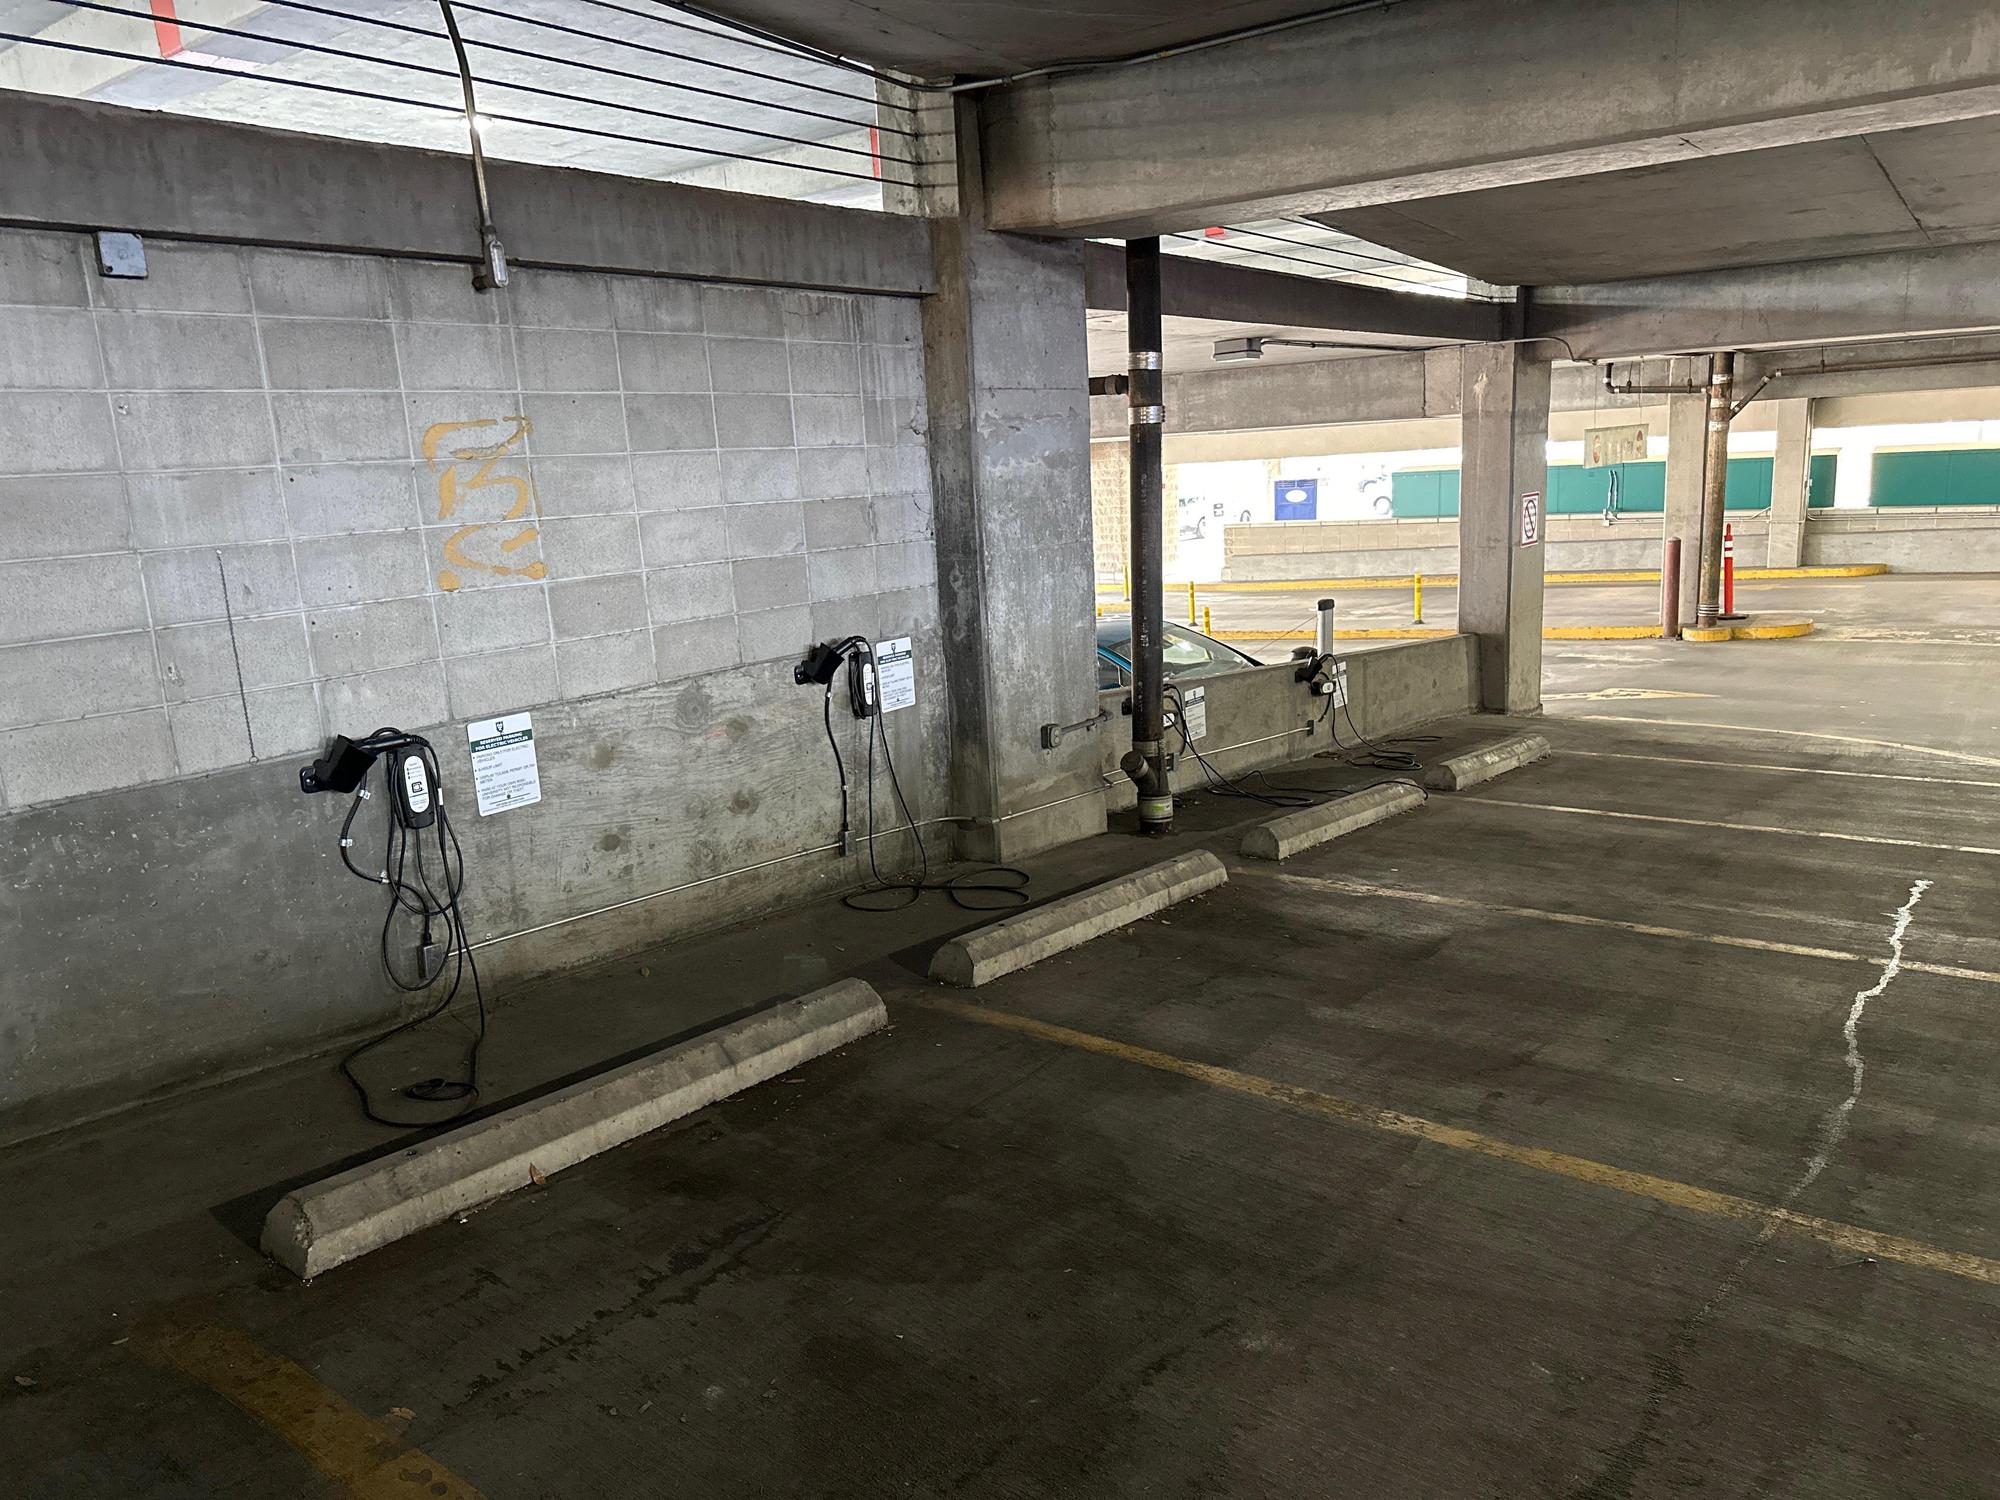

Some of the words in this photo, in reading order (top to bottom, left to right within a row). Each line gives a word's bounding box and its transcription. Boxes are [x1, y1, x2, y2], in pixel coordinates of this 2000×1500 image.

[480, 736, 502, 745] RESERVED
[503, 732, 522, 740] PARKING
[485, 740, 507, 749] ELECTRIC
[508, 736, 528, 744] VEHICLES
